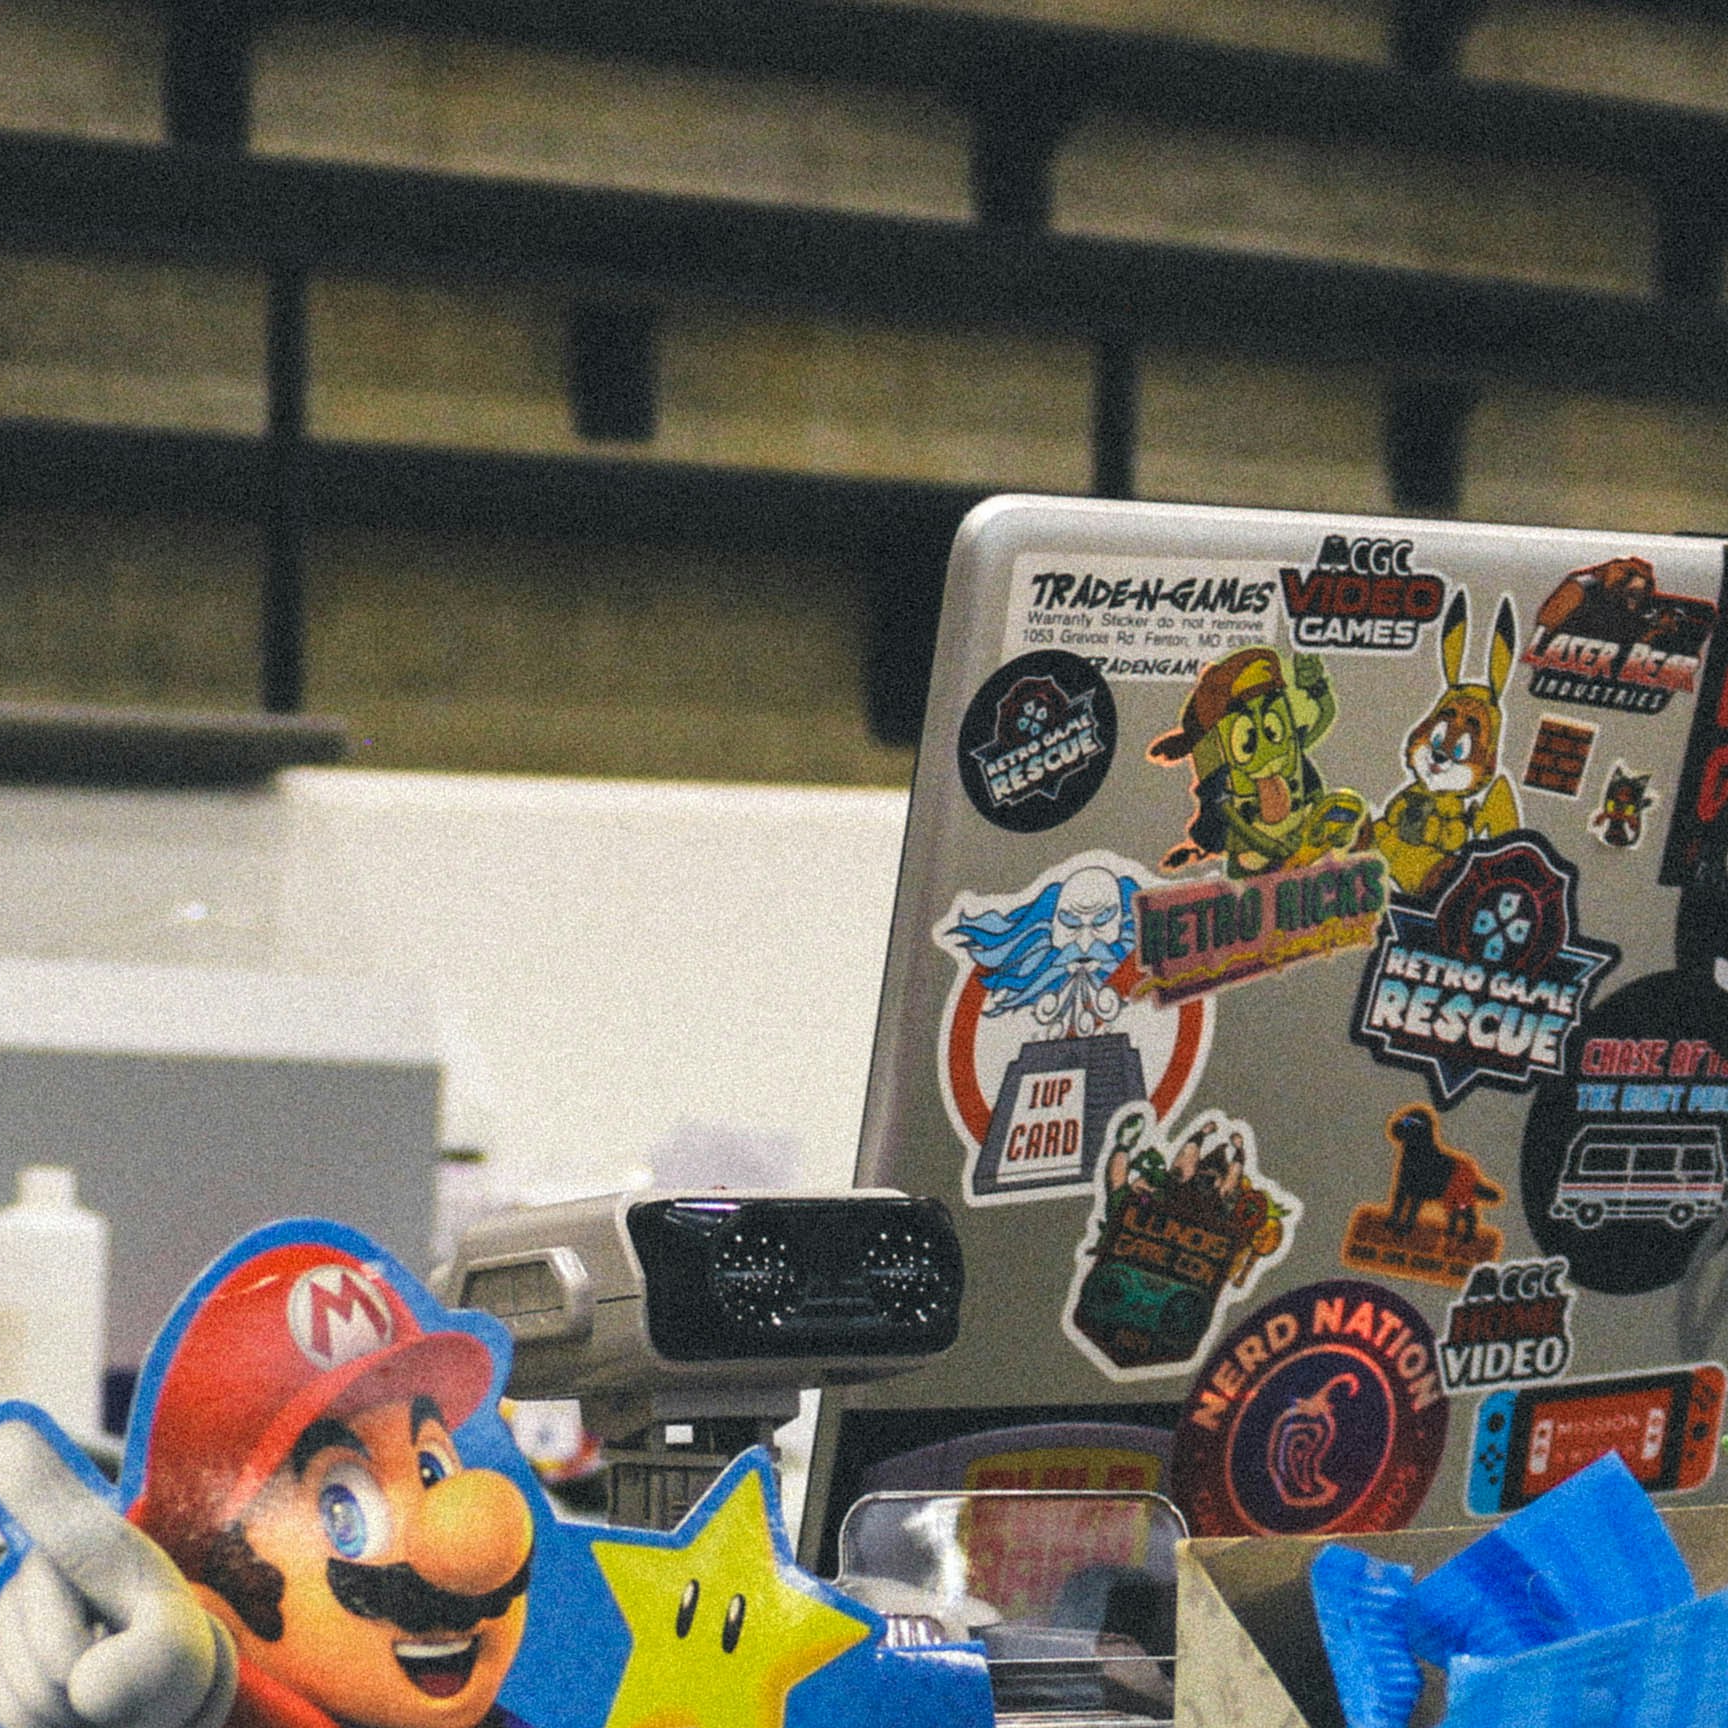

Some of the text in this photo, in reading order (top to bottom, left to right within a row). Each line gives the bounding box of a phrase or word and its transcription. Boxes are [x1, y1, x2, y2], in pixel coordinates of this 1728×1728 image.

[1281, 570, 1444, 622] VIDEO
[1026, 611, 1264, 632] Warranty Sticker do not remove
[1297, 616, 1417, 647] GAMES
[1521, 625, 1621, 680] LASER
[1534, 676, 1664, 711] INDUSTRIES
[990, 728, 1098, 799] RESCUE
[1141, 886, 1263, 966] RETRO
[1386, 946, 1578, 1014] RETRO GAME
[1371, 978, 1568, 1066] RESCUE
[1028, 1077, 1074, 1110] 1UP
[1006, 1118, 1080, 1163] CARD
[1190, 1297, 1441, 1431] NERD NATION
[1444, 1335, 1565, 1382] VIDEO
[1556, 1415, 1641, 1436] MISSION
